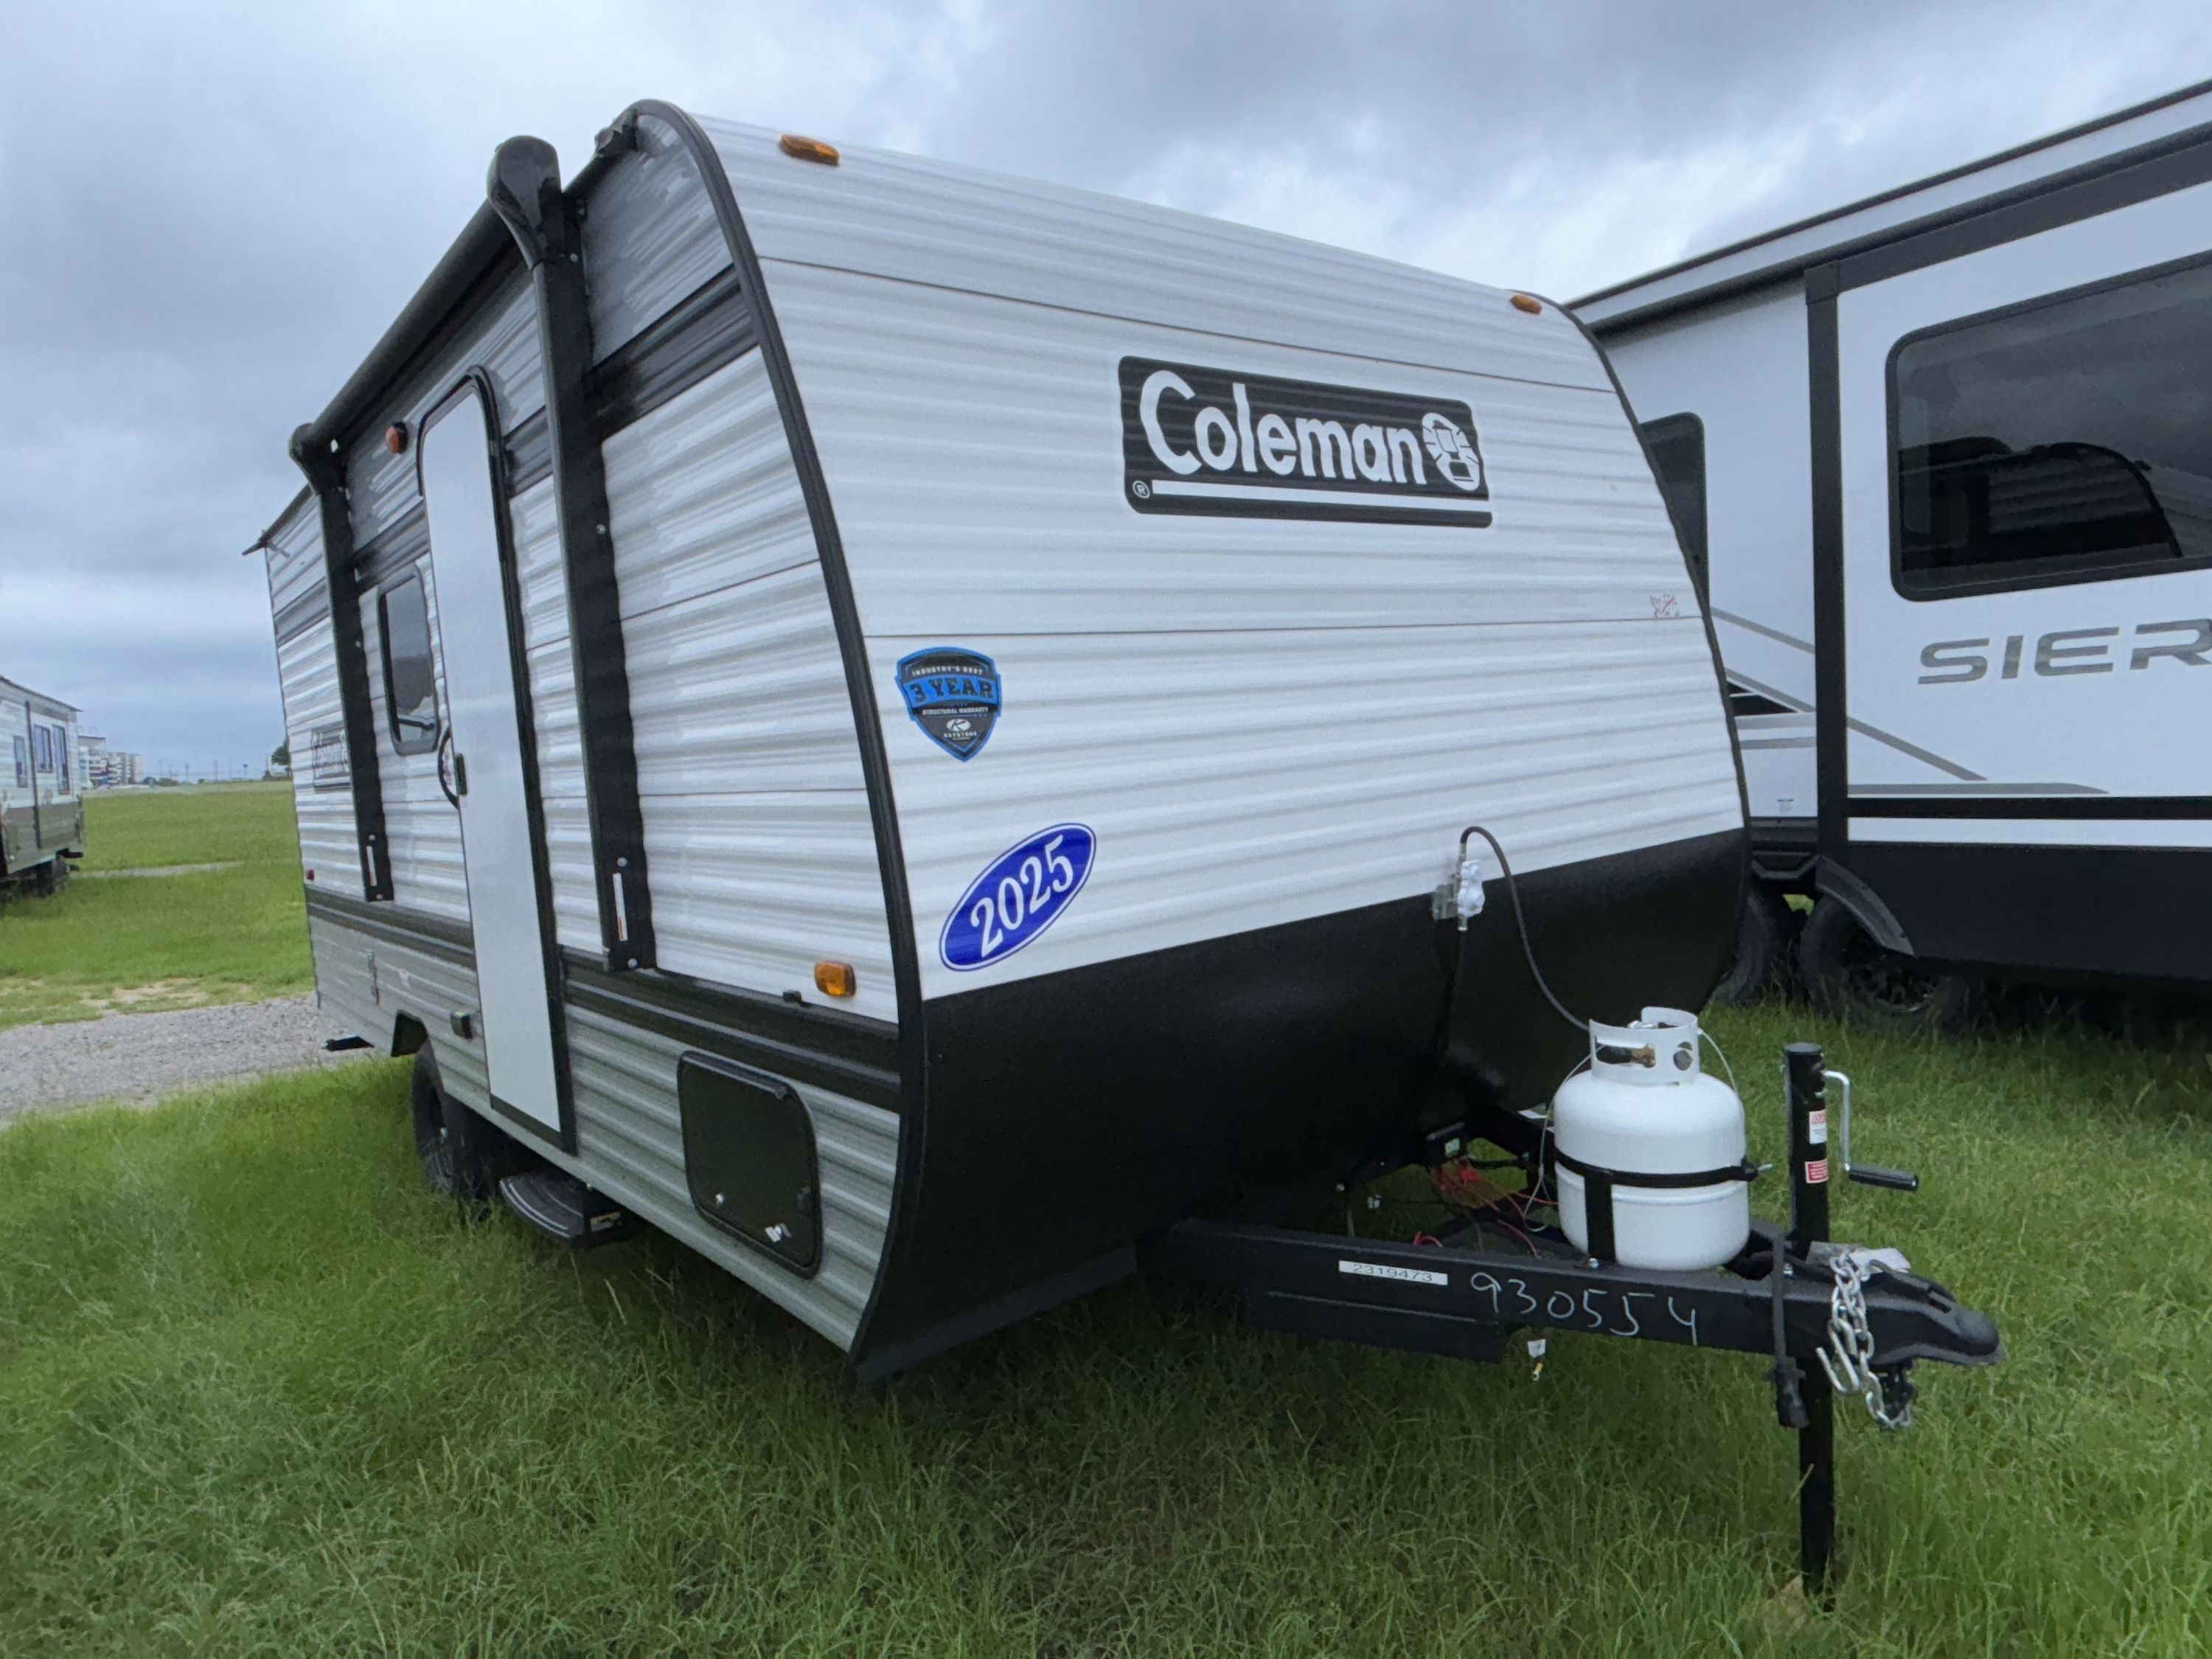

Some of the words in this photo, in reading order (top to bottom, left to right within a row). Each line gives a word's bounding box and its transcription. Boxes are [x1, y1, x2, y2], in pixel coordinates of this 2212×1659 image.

[1140, 370, 1426, 484] Coleman
[963, 666, 983, 675] BEST
[1918, 618, 2212, 684] SIER
[909, 684, 927, 703] 3
[928, 678, 993, 698] YEAR
[970, 835, 1074, 957] 2025
[1353, 1263, 1433, 1281] 2319473
[1470, 1273, 1697, 1345] 930554
